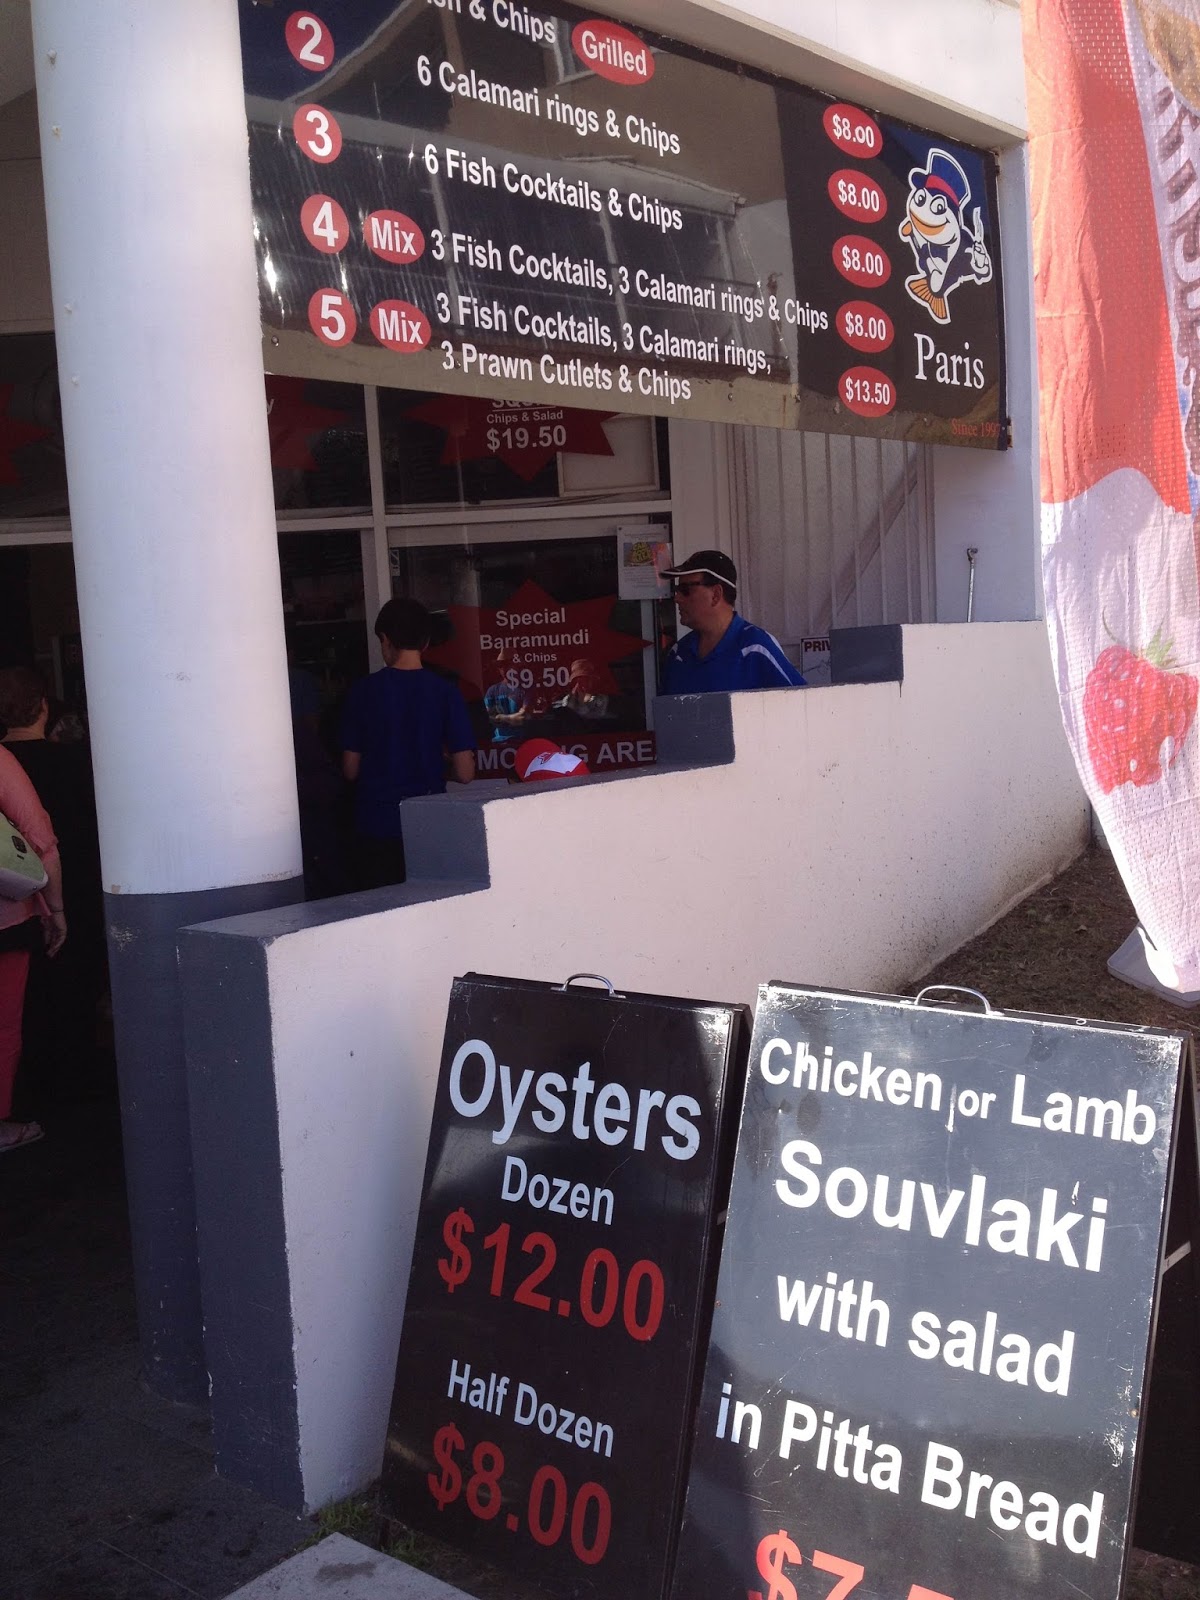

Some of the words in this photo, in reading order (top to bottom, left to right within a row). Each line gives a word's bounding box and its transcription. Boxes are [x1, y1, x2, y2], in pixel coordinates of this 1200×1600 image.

[493, 1, 556, 43] Chips
[582, 30, 648, 76] Grilled
[297, 16, 325, 65] 2
[417, 55, 431, 86] 6
[439, 61, 540, 116] Calamari
[546, 94, 599, 136] rings
[606, 109, 620, 138] &
[625, 115, 681, 157] Chips
[832, 114, 875, 148] $8.00
[306, 110, 333, 157] 3
[425, 143, 439, 174] 6
[446, 148, 497, 188] Fish
[503, 163, 602, 212] Cocktails
[608, 188, 623, 217] &
[628, 193, 683, 233] Chips
[838, 179, 880, 212] $8.00
[312, 201, 339, 247] 4
[371, 217, 417, 256] Mix
[431, 229, 445, 260] 3
[452, 232, 502, 271] Fish
[509, 244, 613, 295] Cocktails,
[618, 266, 630, 294] 3
[636, 269, 716, 310] Calamari
[721, 287, 763, 322] rings
[768, 295, 780, 321] &
[784, 299, 829, 333] Chips
[842, 245, 884, 277] $8.00
[320, 294, 347, 341] 5
[378, 308, 424, 345] Mix
[437, 292, 451, 323] 3
[458, 296, 507, 332] Fish
[513, 305, 618, 353] Cocktails,
[622, 322, 634, 351] 3
[639, 325, 719, 363] Calamari
[724, 340, 771, 375] rings,
[845, 311, 887, 341] $8.00
[441, 341, 454, 370] 3
[462, 342, 532, 381] Prawn
[540, 354, 613, 391] Cutlets
[618, 364, 633, 393] &
[638, 367, 692, 404] Chips
[913, 332, 985, 390] Paris
[845, 376, 890, 405] $13.50
[486, 413, 519, 425] Chips
[521, 411, 530, 422] &
[532, 410, 564, 421] Salad
[486, 424, 567, 452] $19.50
[951, 418, 978, 436] Since
[480, 629, 589, 650] Barramundi
[496, 607, 566, 630] Special
[506, 666, 570, 690] $9.50
[512, 653, 521, 664] &
[524, 652, 557, 664] Chips
[597, 740, 657, 764] ARE
[450, 1039, 702, 1161] Oysters
[760, 1038, 942, 1111] Chicken
[957, 1089, 996, 1119] or
[1010, 1074, 1157, 1145] Lamb
[501, 1155, 615, 1225] Dozen
[775, 1140, 1108, 1272] Souvlaki
[438, 1207, 665, 1341] $12.00
[777, 1272, 890, 1347] with
[908, 1311, 1076, 1396] salad
[447, 1359, 510, 1416] Half
[514, 1382, 614, 1458] Dozen
[427, 1422, 612, 1564] $8.00
[716, 1382, 762, 1449] in
[779, 1399, 903, 1494] Pitta
[920, 1441, 1105, 1559] Bread
